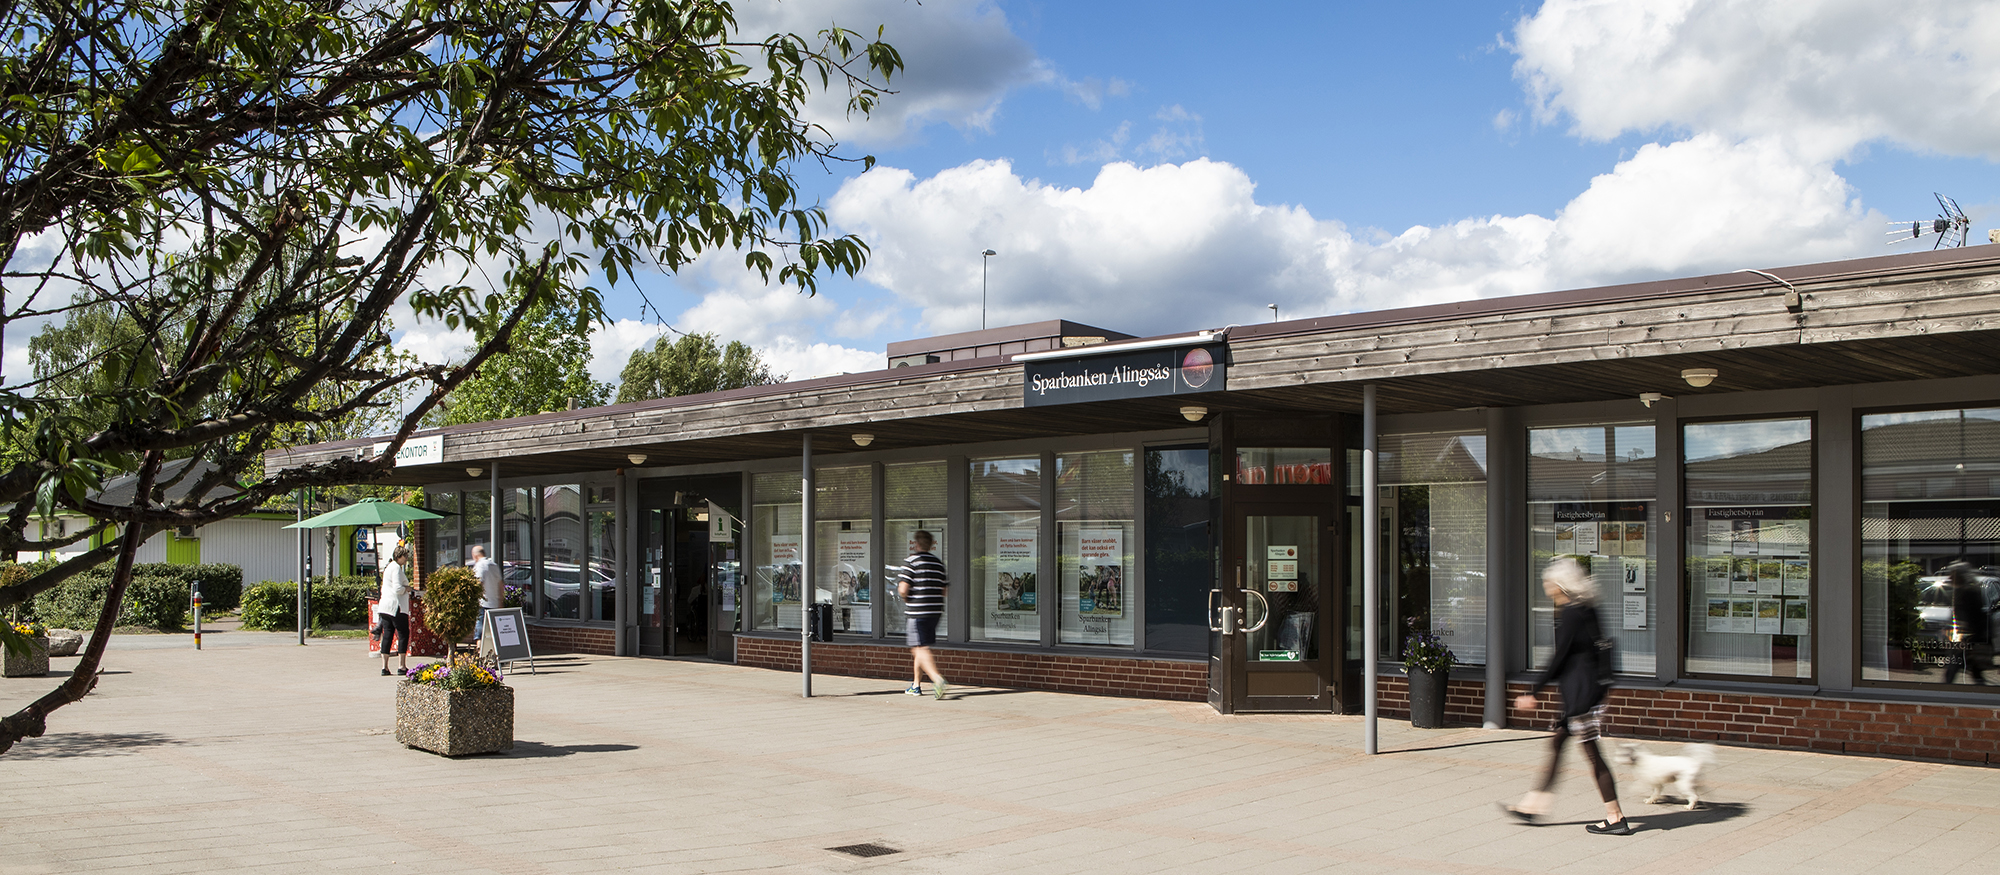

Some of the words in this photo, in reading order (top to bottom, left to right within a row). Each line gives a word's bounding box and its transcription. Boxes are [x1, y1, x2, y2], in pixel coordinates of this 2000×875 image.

[1032, 368, 1107, 396] Sparbanken
[1109, 363, 1170, 388] Alingsås
[1556, 511, 1606, 520] Fastighetsbyrån
[1708, 508, 1764, 519] Fastighetsbyrån
[991, 612, 1021, 621] Sparbanken
[1078, 614, 1111, 624] Sparbanken
[1083, 625, 1107, 635] Alingsås
[1904, 637, 1973, 651] Sparbanken
